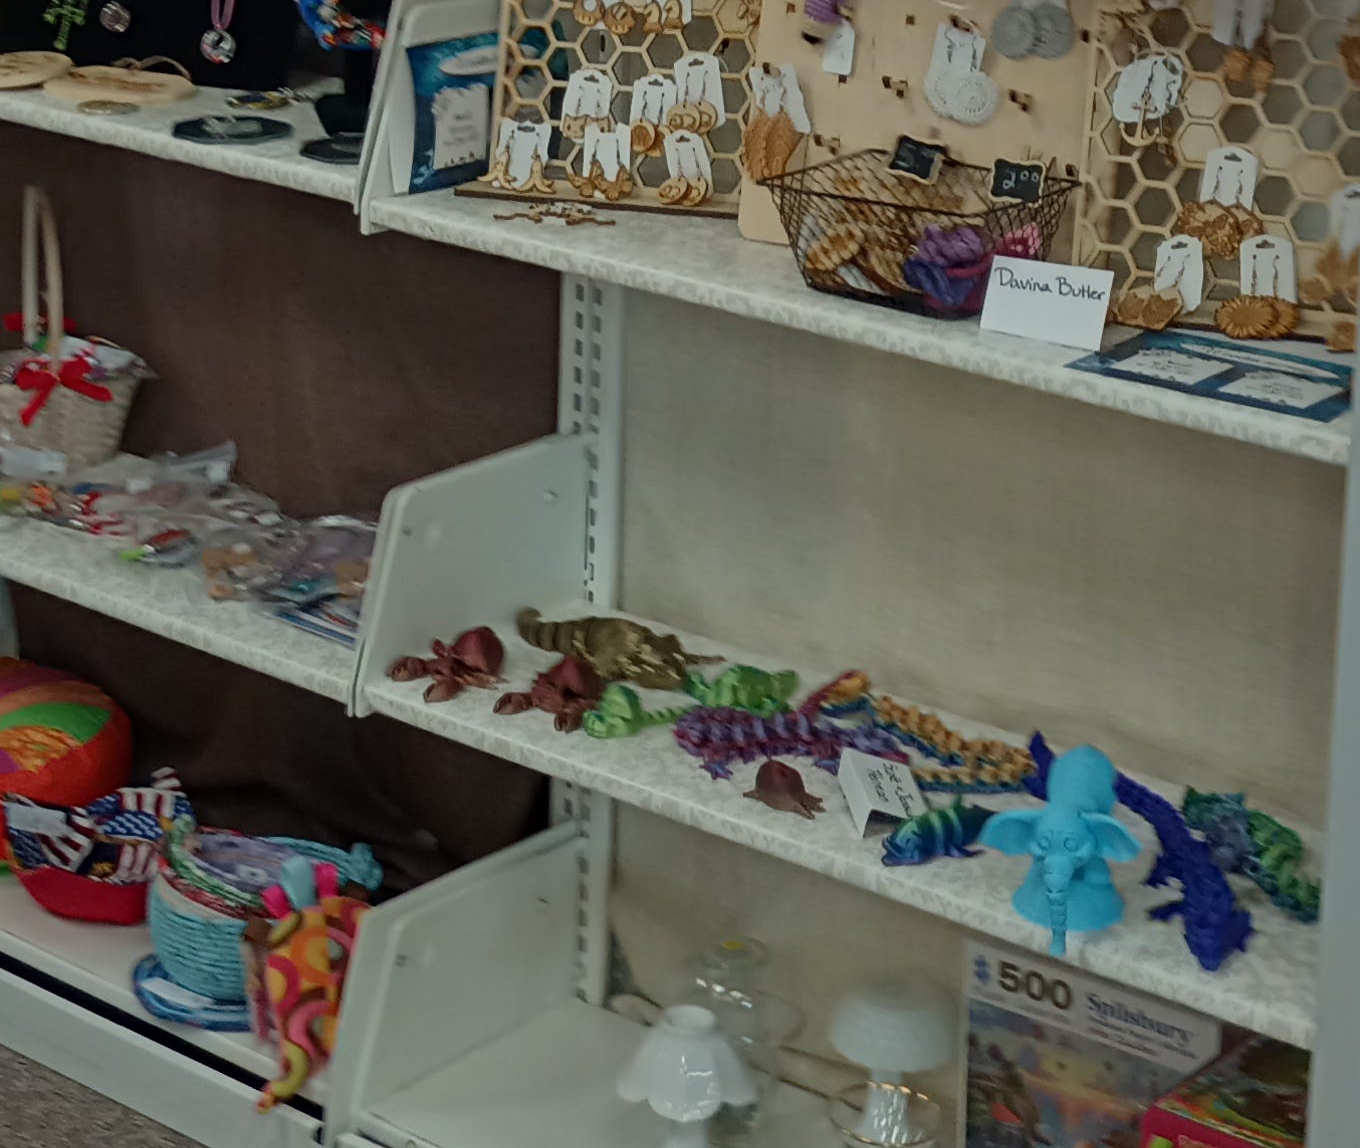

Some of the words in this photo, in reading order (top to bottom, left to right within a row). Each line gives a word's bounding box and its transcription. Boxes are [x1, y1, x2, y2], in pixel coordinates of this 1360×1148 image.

[995, 266, 1052, 294] Davina
[1055, 275, 1106, 302] Butler
[996, 959, 1074, 1011] 500
[1087, 991, 1196, 1042] Spilsbury
